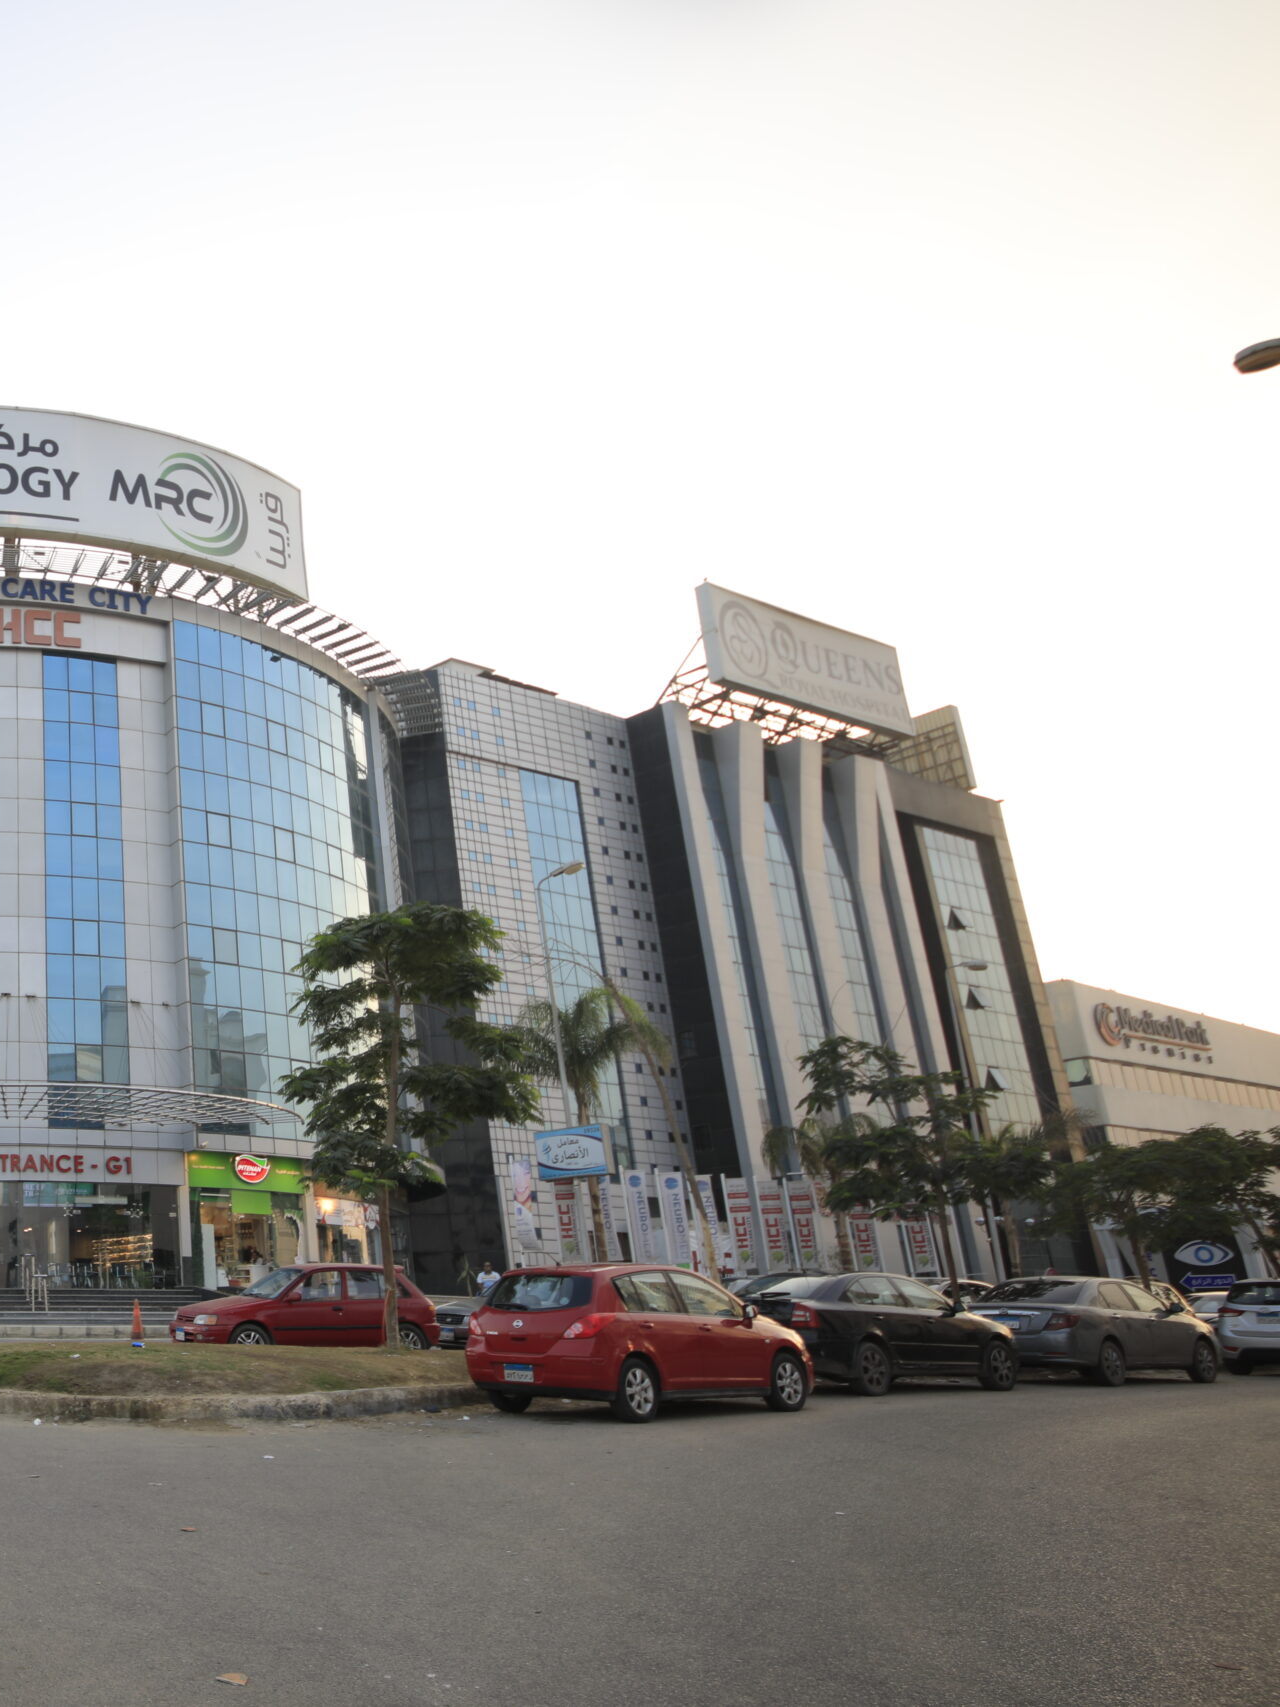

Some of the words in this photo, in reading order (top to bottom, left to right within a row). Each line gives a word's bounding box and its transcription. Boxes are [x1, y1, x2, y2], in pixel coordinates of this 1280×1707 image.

[109, 469, 215, 524] MRC
[1, 578, 76, 604] CARE
[88, 586, 153, 615] CITY
[771, 621, 902, 697] QUEENS
[1116, 1006, 1176, 1040] Medical
[1175, 1018, 1211, 1046] Park
[556, 1136, 580, 1149] معامل
[106, 1155, 133, 1175] G1
[557, 1203, 575, 1239] HCC
[733, 1215, 749, 1249] HCC
[764, 1216, 783, 1250] HCC
[797, 1217, 813, 1249] HCC
[855, 1223, 872, 1254] HCC
[911, 1226, 928, 1255] HCC
